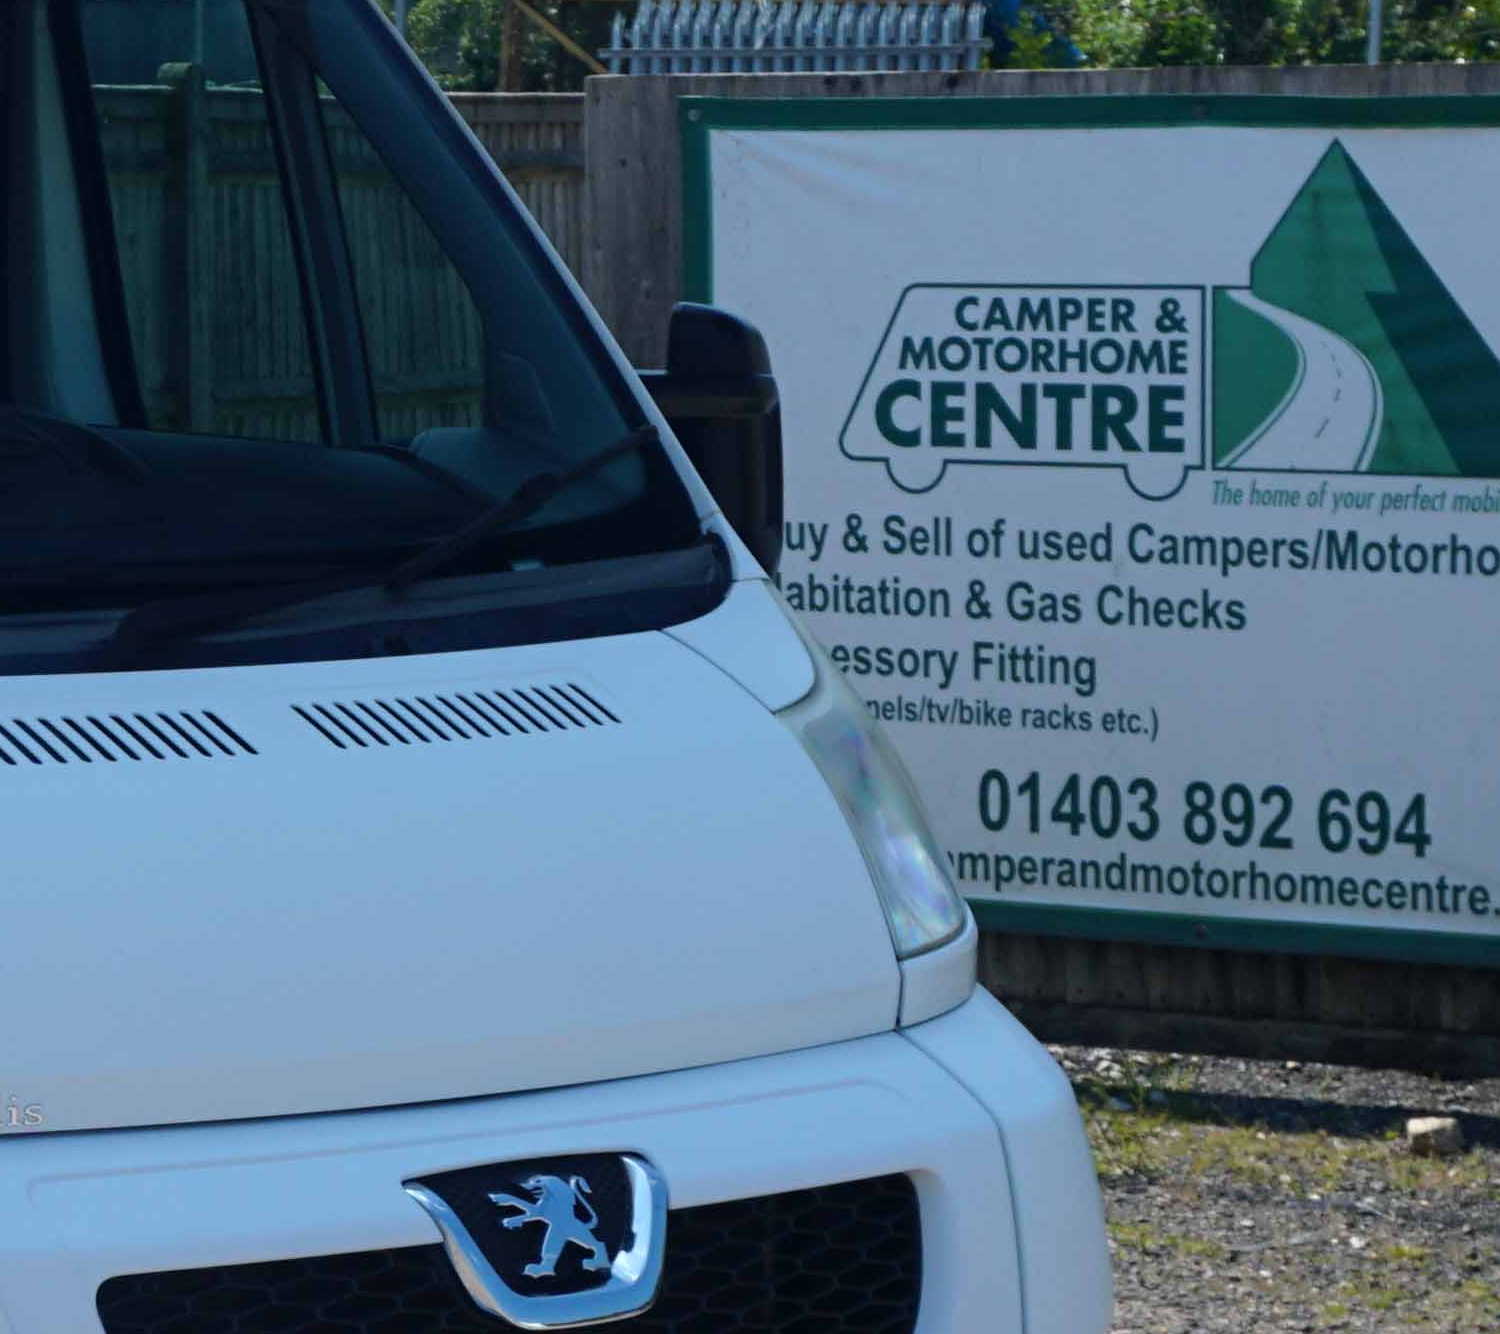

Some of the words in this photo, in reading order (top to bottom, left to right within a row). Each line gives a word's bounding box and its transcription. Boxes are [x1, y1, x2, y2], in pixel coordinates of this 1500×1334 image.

[953, 296, 1137, 333] CAMPER
[1154, 297, 1190, 334] &
[899, 335, 1189, 375] MOTORHOME
[874, 377, 1187, 454] CENTRE
[1211, 478, 1244, 506] The
[1249, 478, 1301, 508] home
[1305, 480, 1329, 509] of
[1330, 489, 1377, 517] your
[1379, 482, 1448, 516] perfect
[784, 521, 830, 563] uy
[842, 512, 870, 554] &
[882, 513, 954, 558] Sell
[967, 518, 1007, 559] of
[1017, 522, 1113, 563] used
[964, 578, 993, 621] &
[1005, 580, 1084, 625] Gas
[1096, 584, 1247, 631] Checks
[830, 643, 959, 690] essory
[972, 640, 1098, 698] Fitting
[866, 694, 1013, 728] nels/tv/bike
[1020, 701, 1094, 733] racks
[1100, 705, 1160, 743] etc.)
[977, 768, 1161, 844] 01403
[1183, 780, 1294, 851] 892
[1316, 787, 1432, 859] 694
